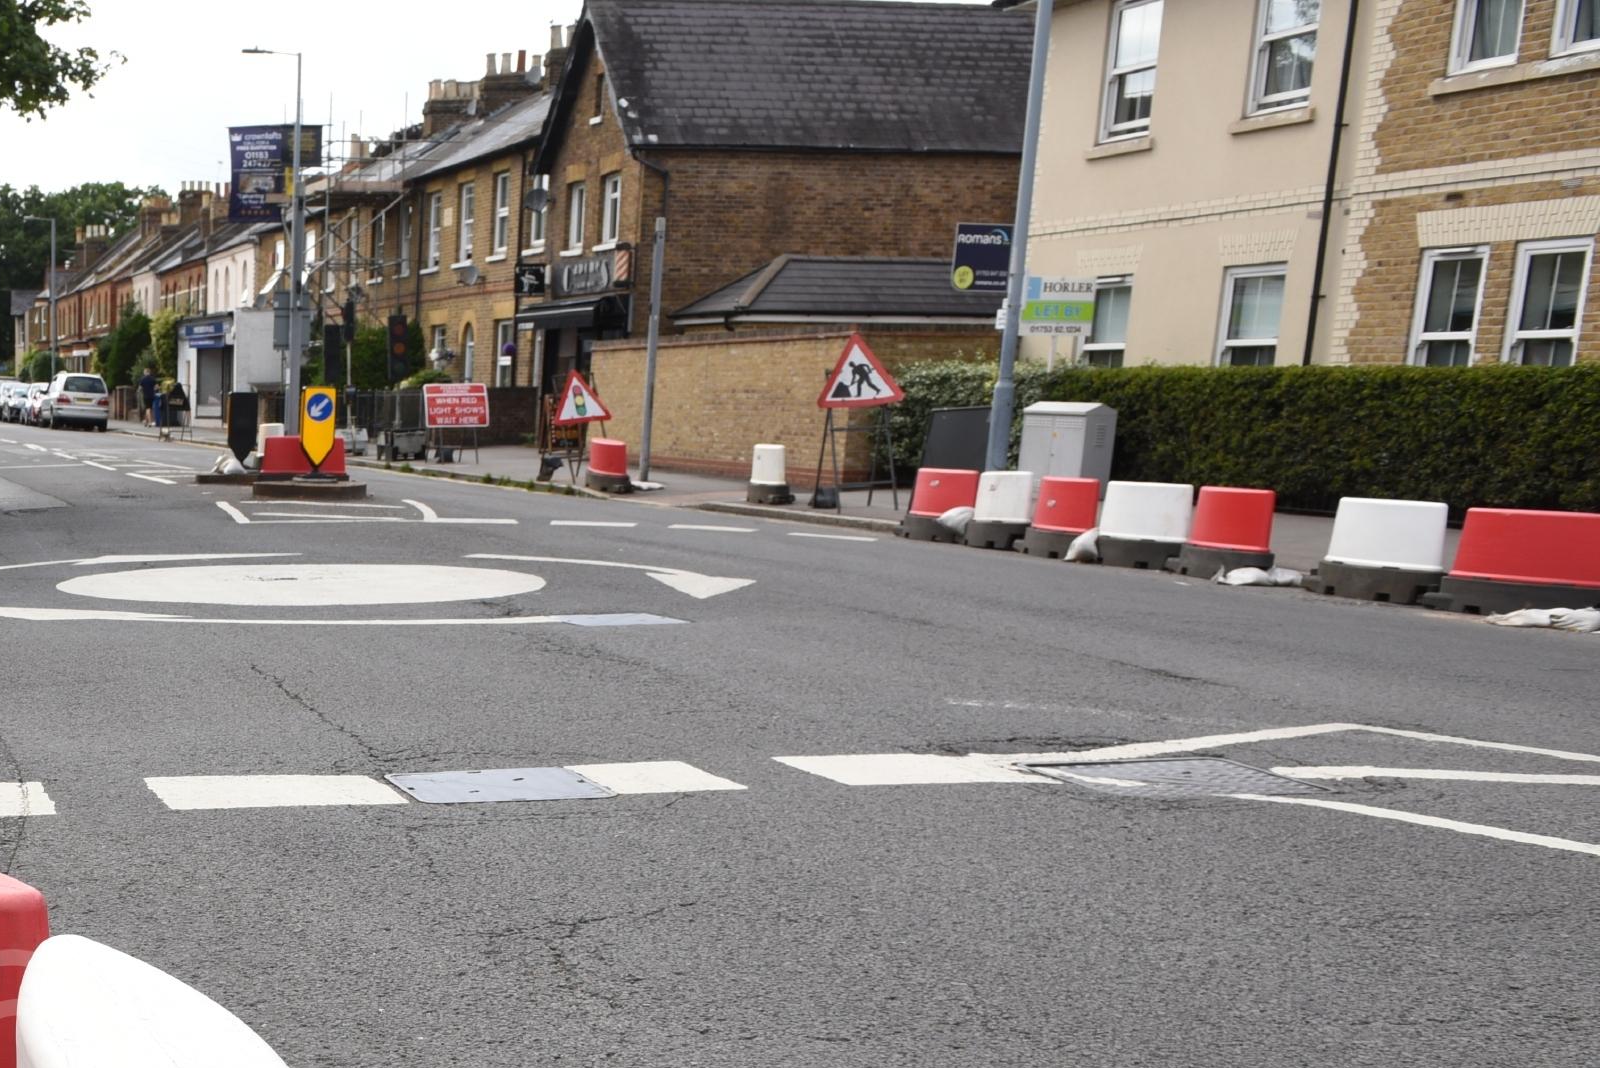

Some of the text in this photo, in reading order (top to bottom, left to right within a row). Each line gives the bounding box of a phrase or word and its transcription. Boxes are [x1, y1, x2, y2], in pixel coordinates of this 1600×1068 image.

[1043, 282, 1093, 293] HORLER
[1034, 304, 1082, 317] LET BY
[429, 406, 485, 415] LIGHT SHOWS
[436, 416, 480, 425] WAIT HERE
